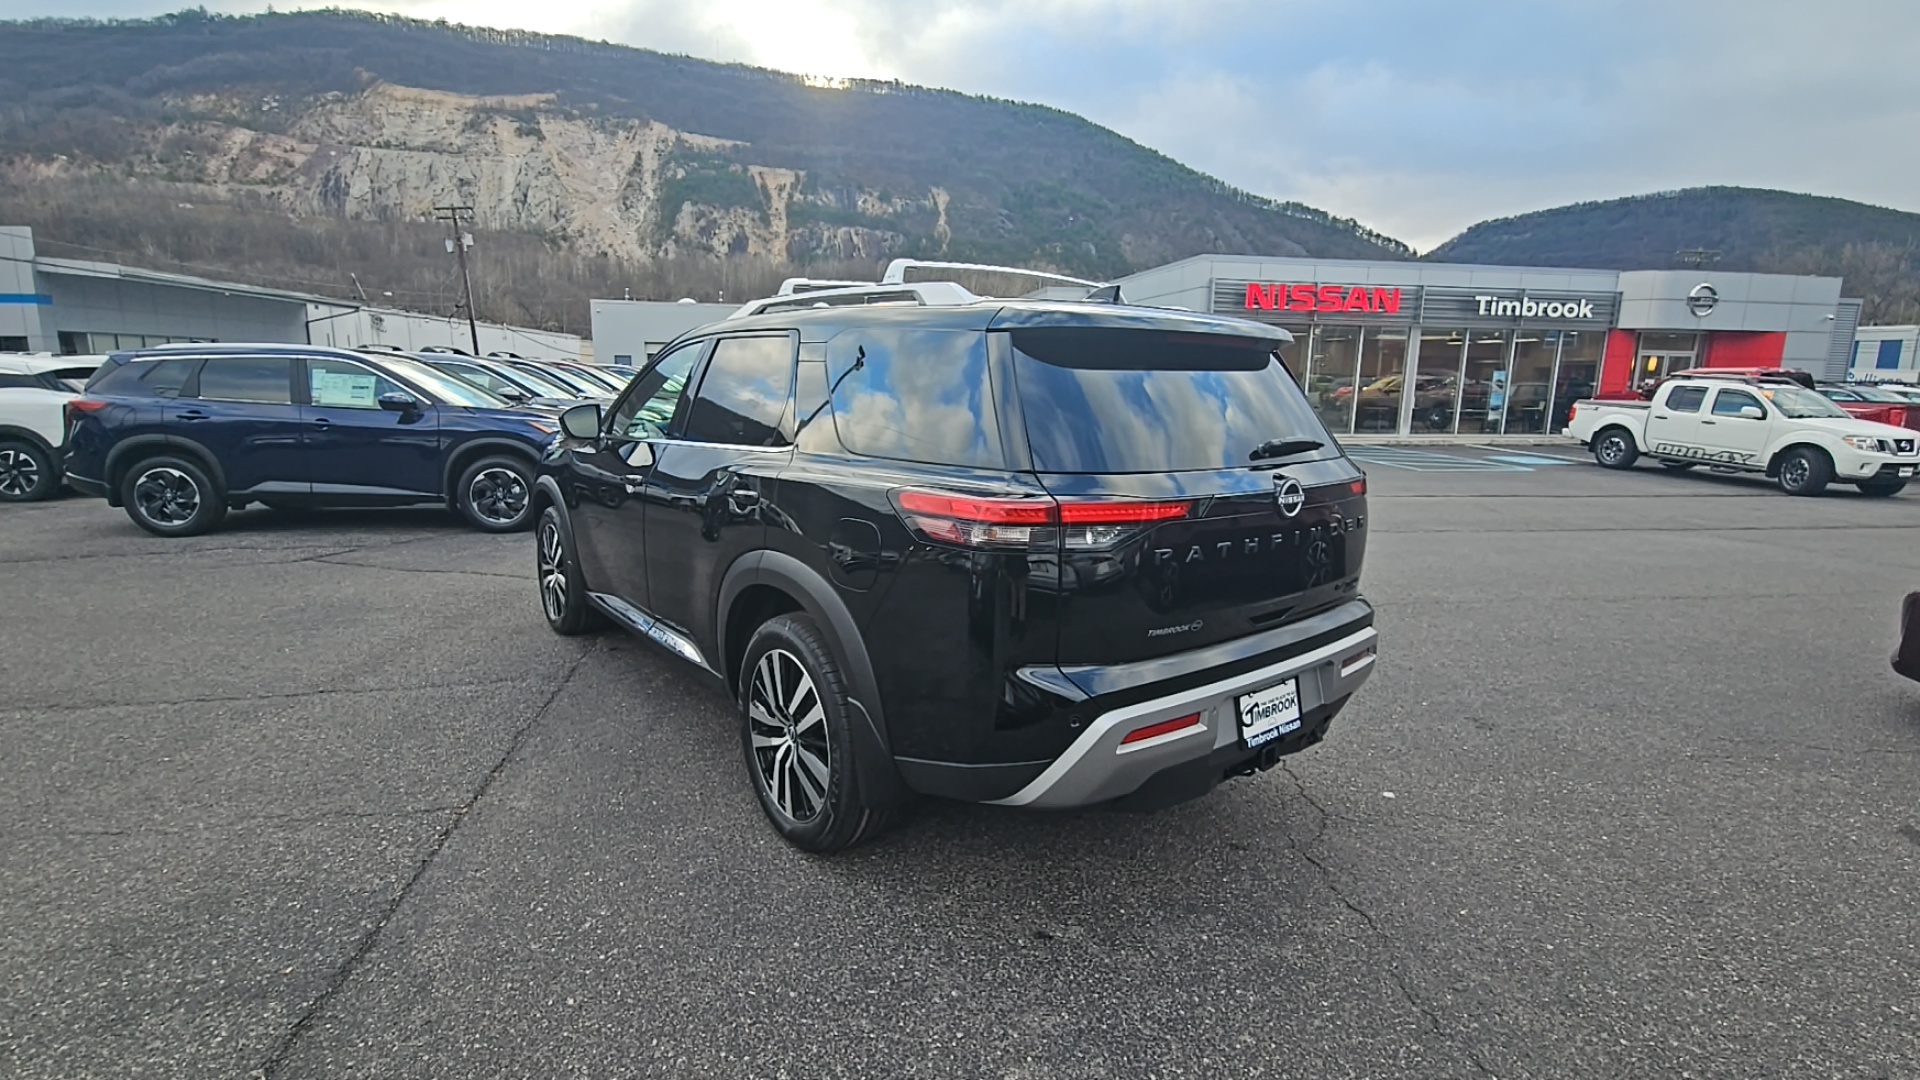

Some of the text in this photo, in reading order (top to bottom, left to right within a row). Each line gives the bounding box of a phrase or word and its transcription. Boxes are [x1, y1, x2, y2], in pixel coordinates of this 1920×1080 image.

[1245, 283, 1401, 314] NISSAN
[1475, 295, 1594, 319] Timbrook
[1154, 515, 1365, 566] PATHFINDER
[1147, 624, 1191, 637] TIMBROOK
[1241, 695, 1297, 728] TIMBROOK
[1246, 720, 1301, 748] Timbrook Nissan
